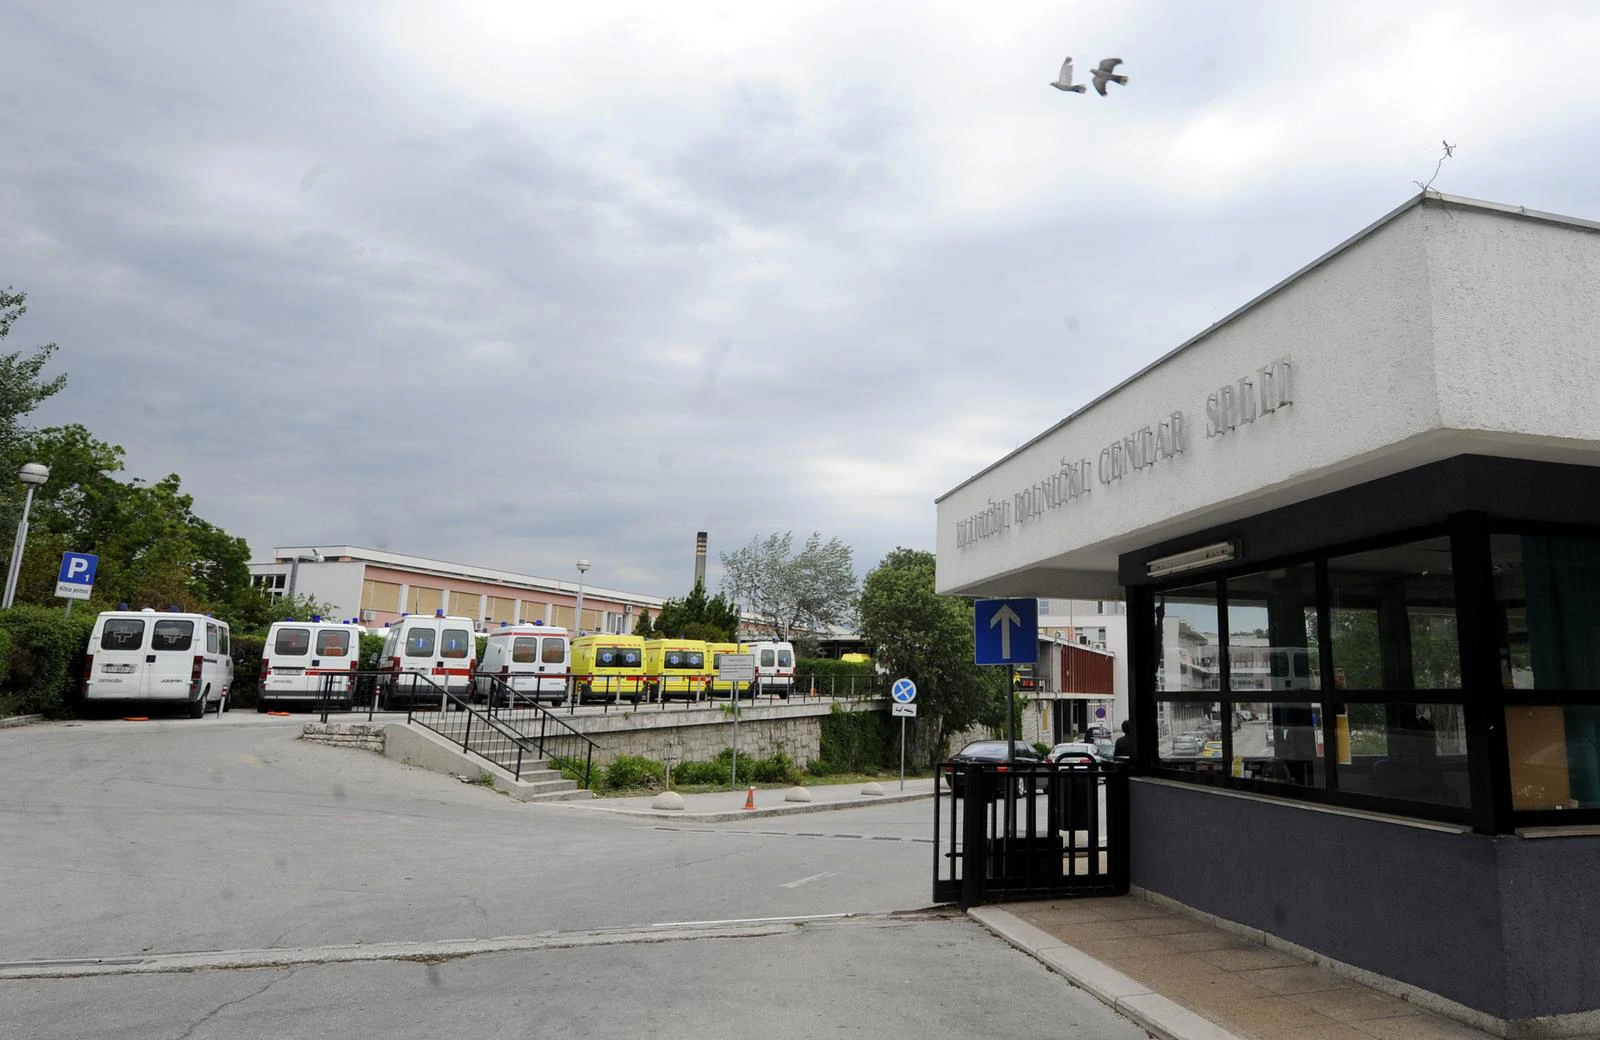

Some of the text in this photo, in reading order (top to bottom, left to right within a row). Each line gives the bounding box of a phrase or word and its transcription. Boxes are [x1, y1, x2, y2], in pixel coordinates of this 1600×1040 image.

[1014, 456, 1092, 524] BOLNIČKI
[1098, 411, 1186, 484] CENTAR
[1206, 356, 1293, 439] SPLIT
[67, 557, 90, 582] P 1
